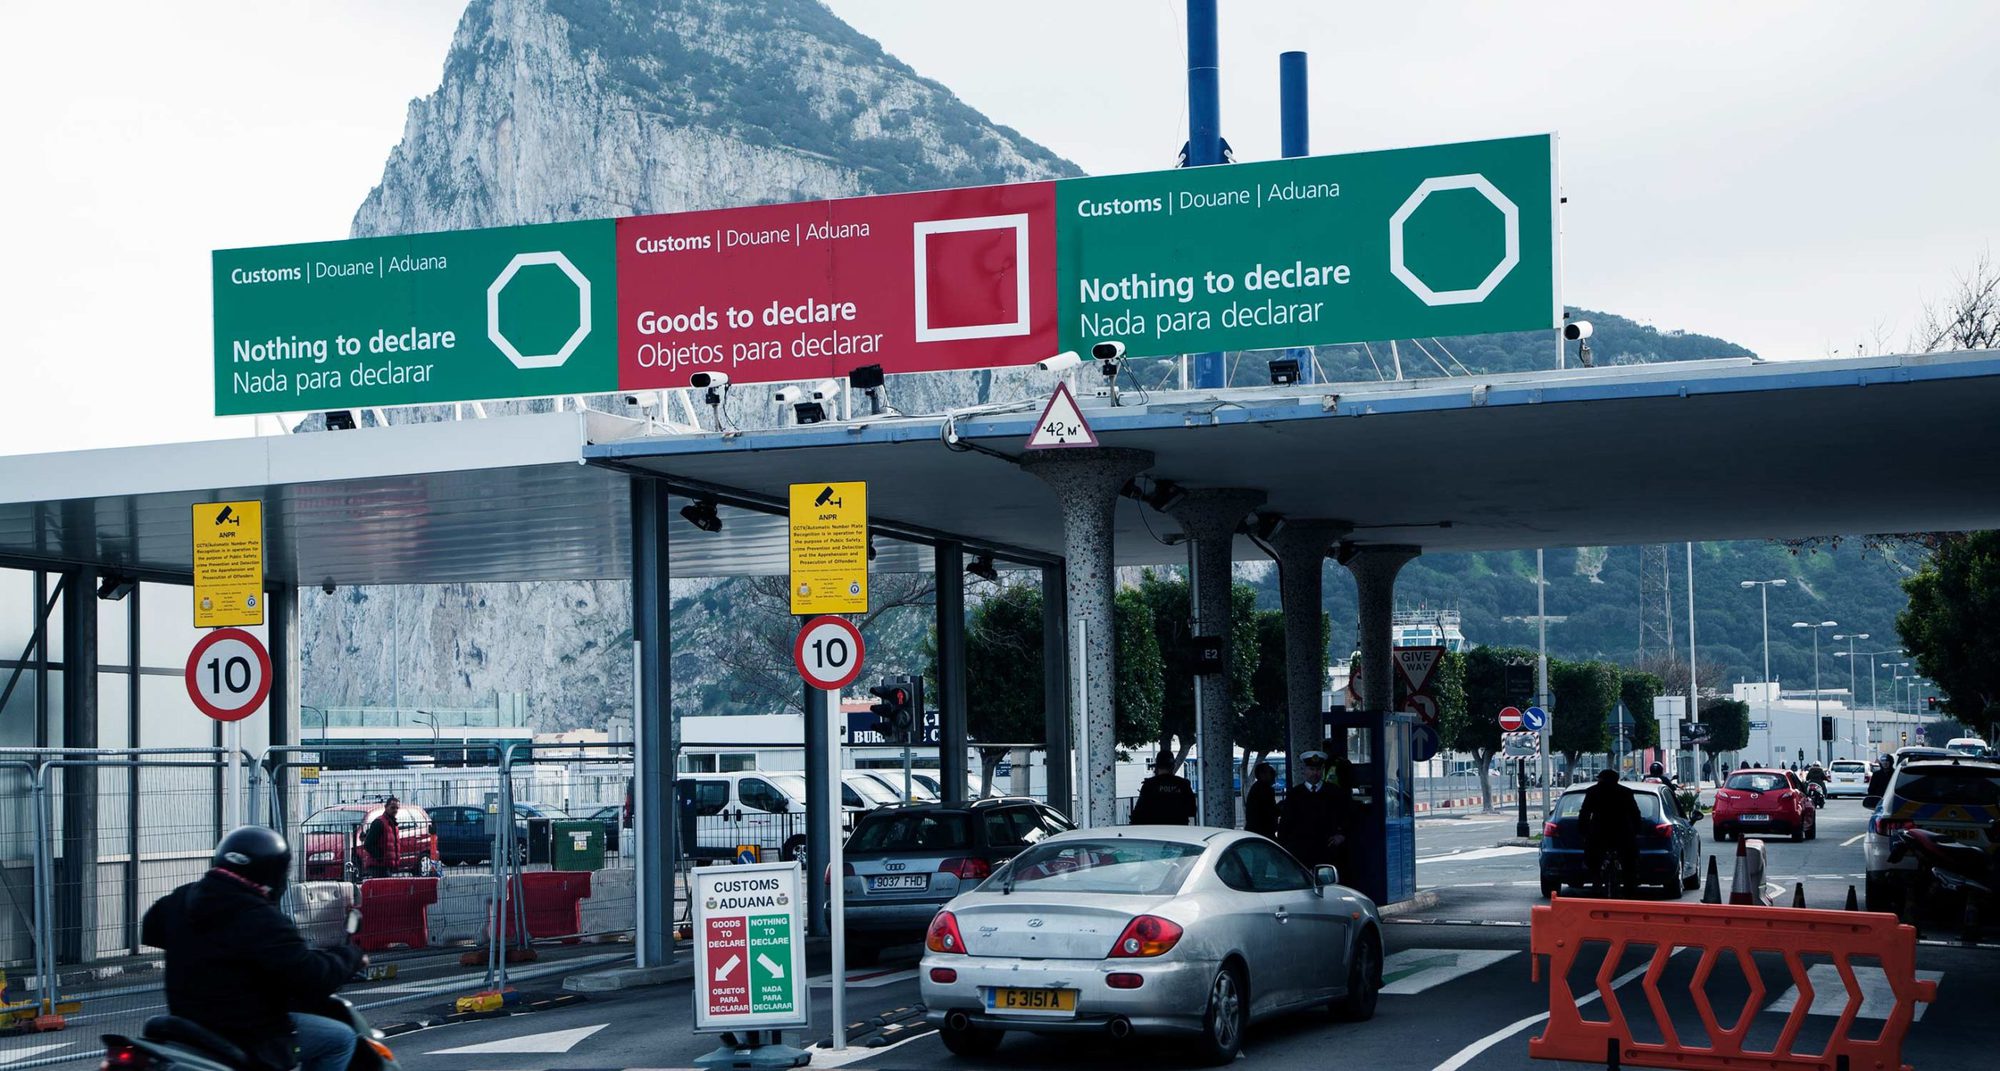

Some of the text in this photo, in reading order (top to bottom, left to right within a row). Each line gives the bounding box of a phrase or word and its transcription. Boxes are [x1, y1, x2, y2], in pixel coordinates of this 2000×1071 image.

[1078, 194, 1163, 218] Customs
[1179, 187, 1251, 210] Douane
[1267, 181, 1340, 202] Aduana
[635, 234, 711, 254] Customs
[726, 228, 790, 247] Douane
[805, 221, 870, 241] Aduana
[231, 266, 302, 285] Customs
[316, 259, 374, 279] Douane
[388, 254, 447, 273] Aduana
[1080, 261, 1351, 304] Nothing to declare
[637, 298, 856, 335] Goods to declare
[1081, 298, 1324, 339] Nada para declarar
[232, 327, 456, 364] Nothing to declare
[637, 331, 883, 372] Objetos para declarar
[233, 360, 434, 396] Nada para declarar
[812, 638, 848, 668] 10
[1402, 652, 1430, 662] GIVE
[208, 656, 251, 693] 10
[714, 879, 779, 893] CUSTOMS
[877, 876, 922, 887] 9037 FHD
[720, 896, 774, 909] ADUANA
[712, 920, 741, 929] GOODS
[751, 917, 788, 926] NOTHING
[709, 940, 746, 948] DECLARE
[751, 937, 789, 946] DECLARE
[713, 987, 745, 995] OBJETOS
[1007, 991, 1059, 1007] G 3151 A
